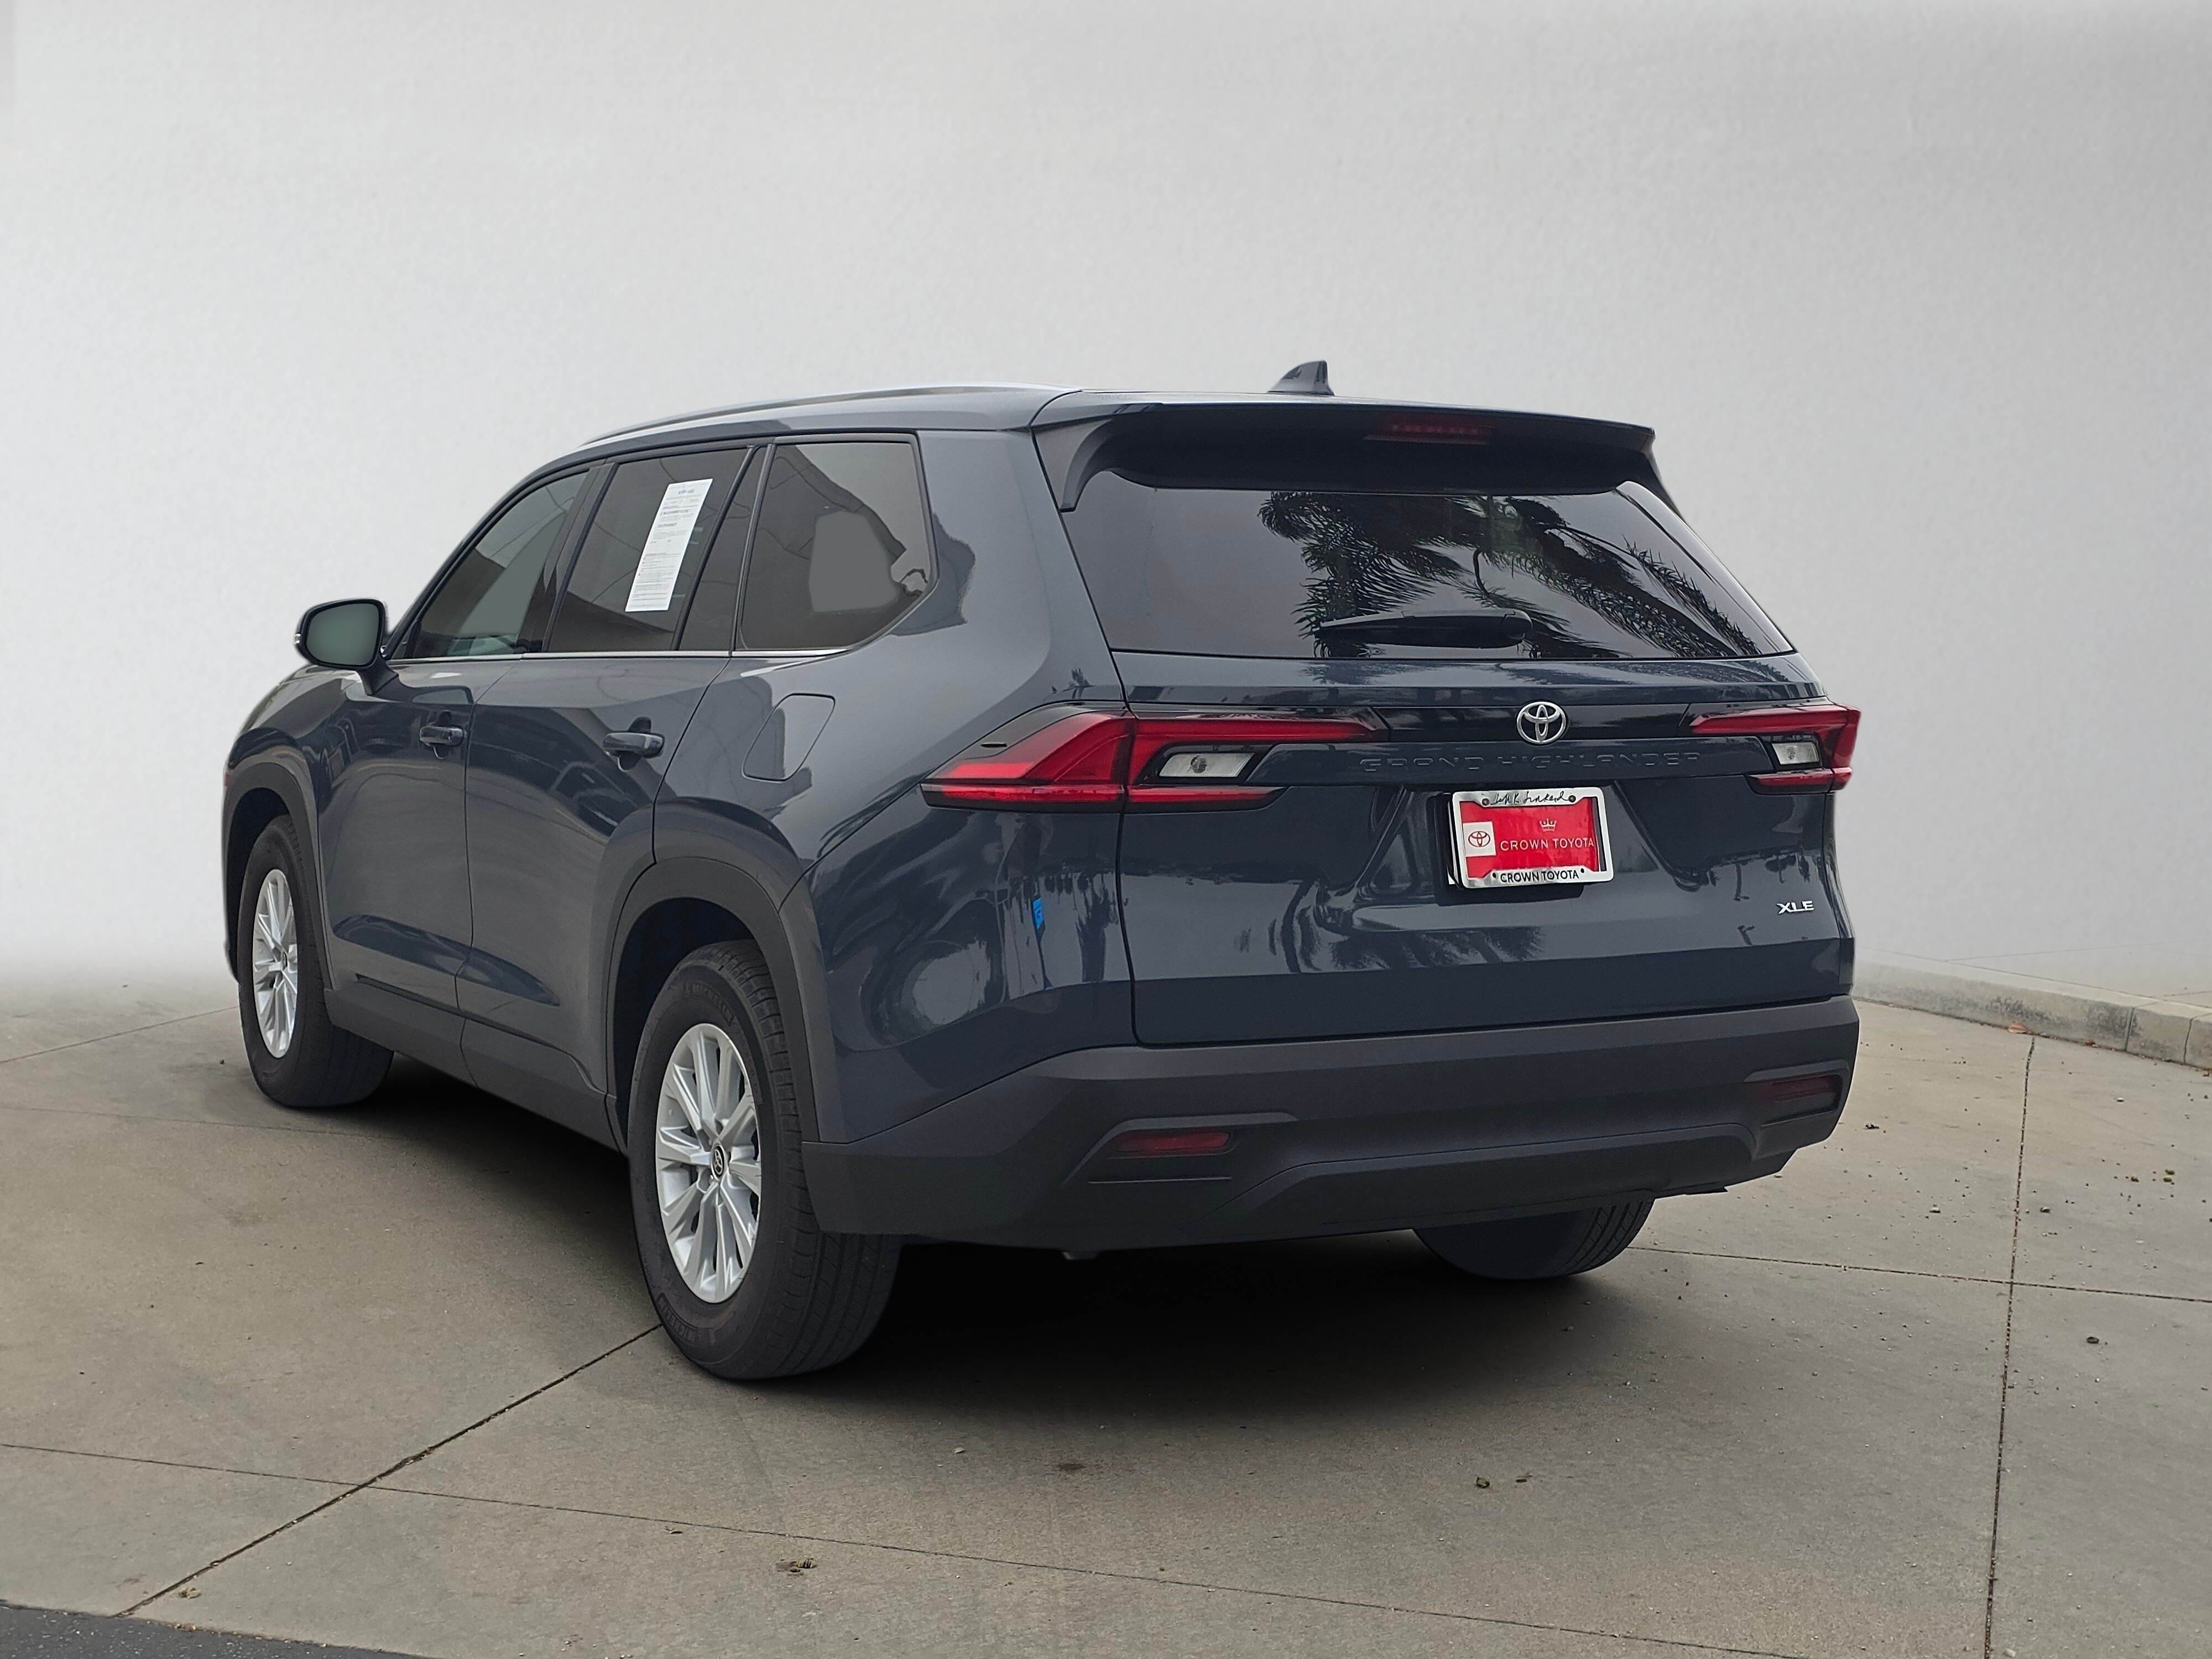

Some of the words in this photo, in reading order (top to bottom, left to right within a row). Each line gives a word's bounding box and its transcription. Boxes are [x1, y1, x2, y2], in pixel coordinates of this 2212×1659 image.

[1360, 757, 1484, 774] GRAND
[1497, 752, 1703, 771] HIGHLANDER
[1500, 839, 1549, 852] CROWN
[1552, 837, 1595, 849] TOYOTA
[1500, 871, 1542, 883] CROWN
[1541, 869, 1579, 881] TOYOTA
[1776, 900, 1814, 915] XLE
